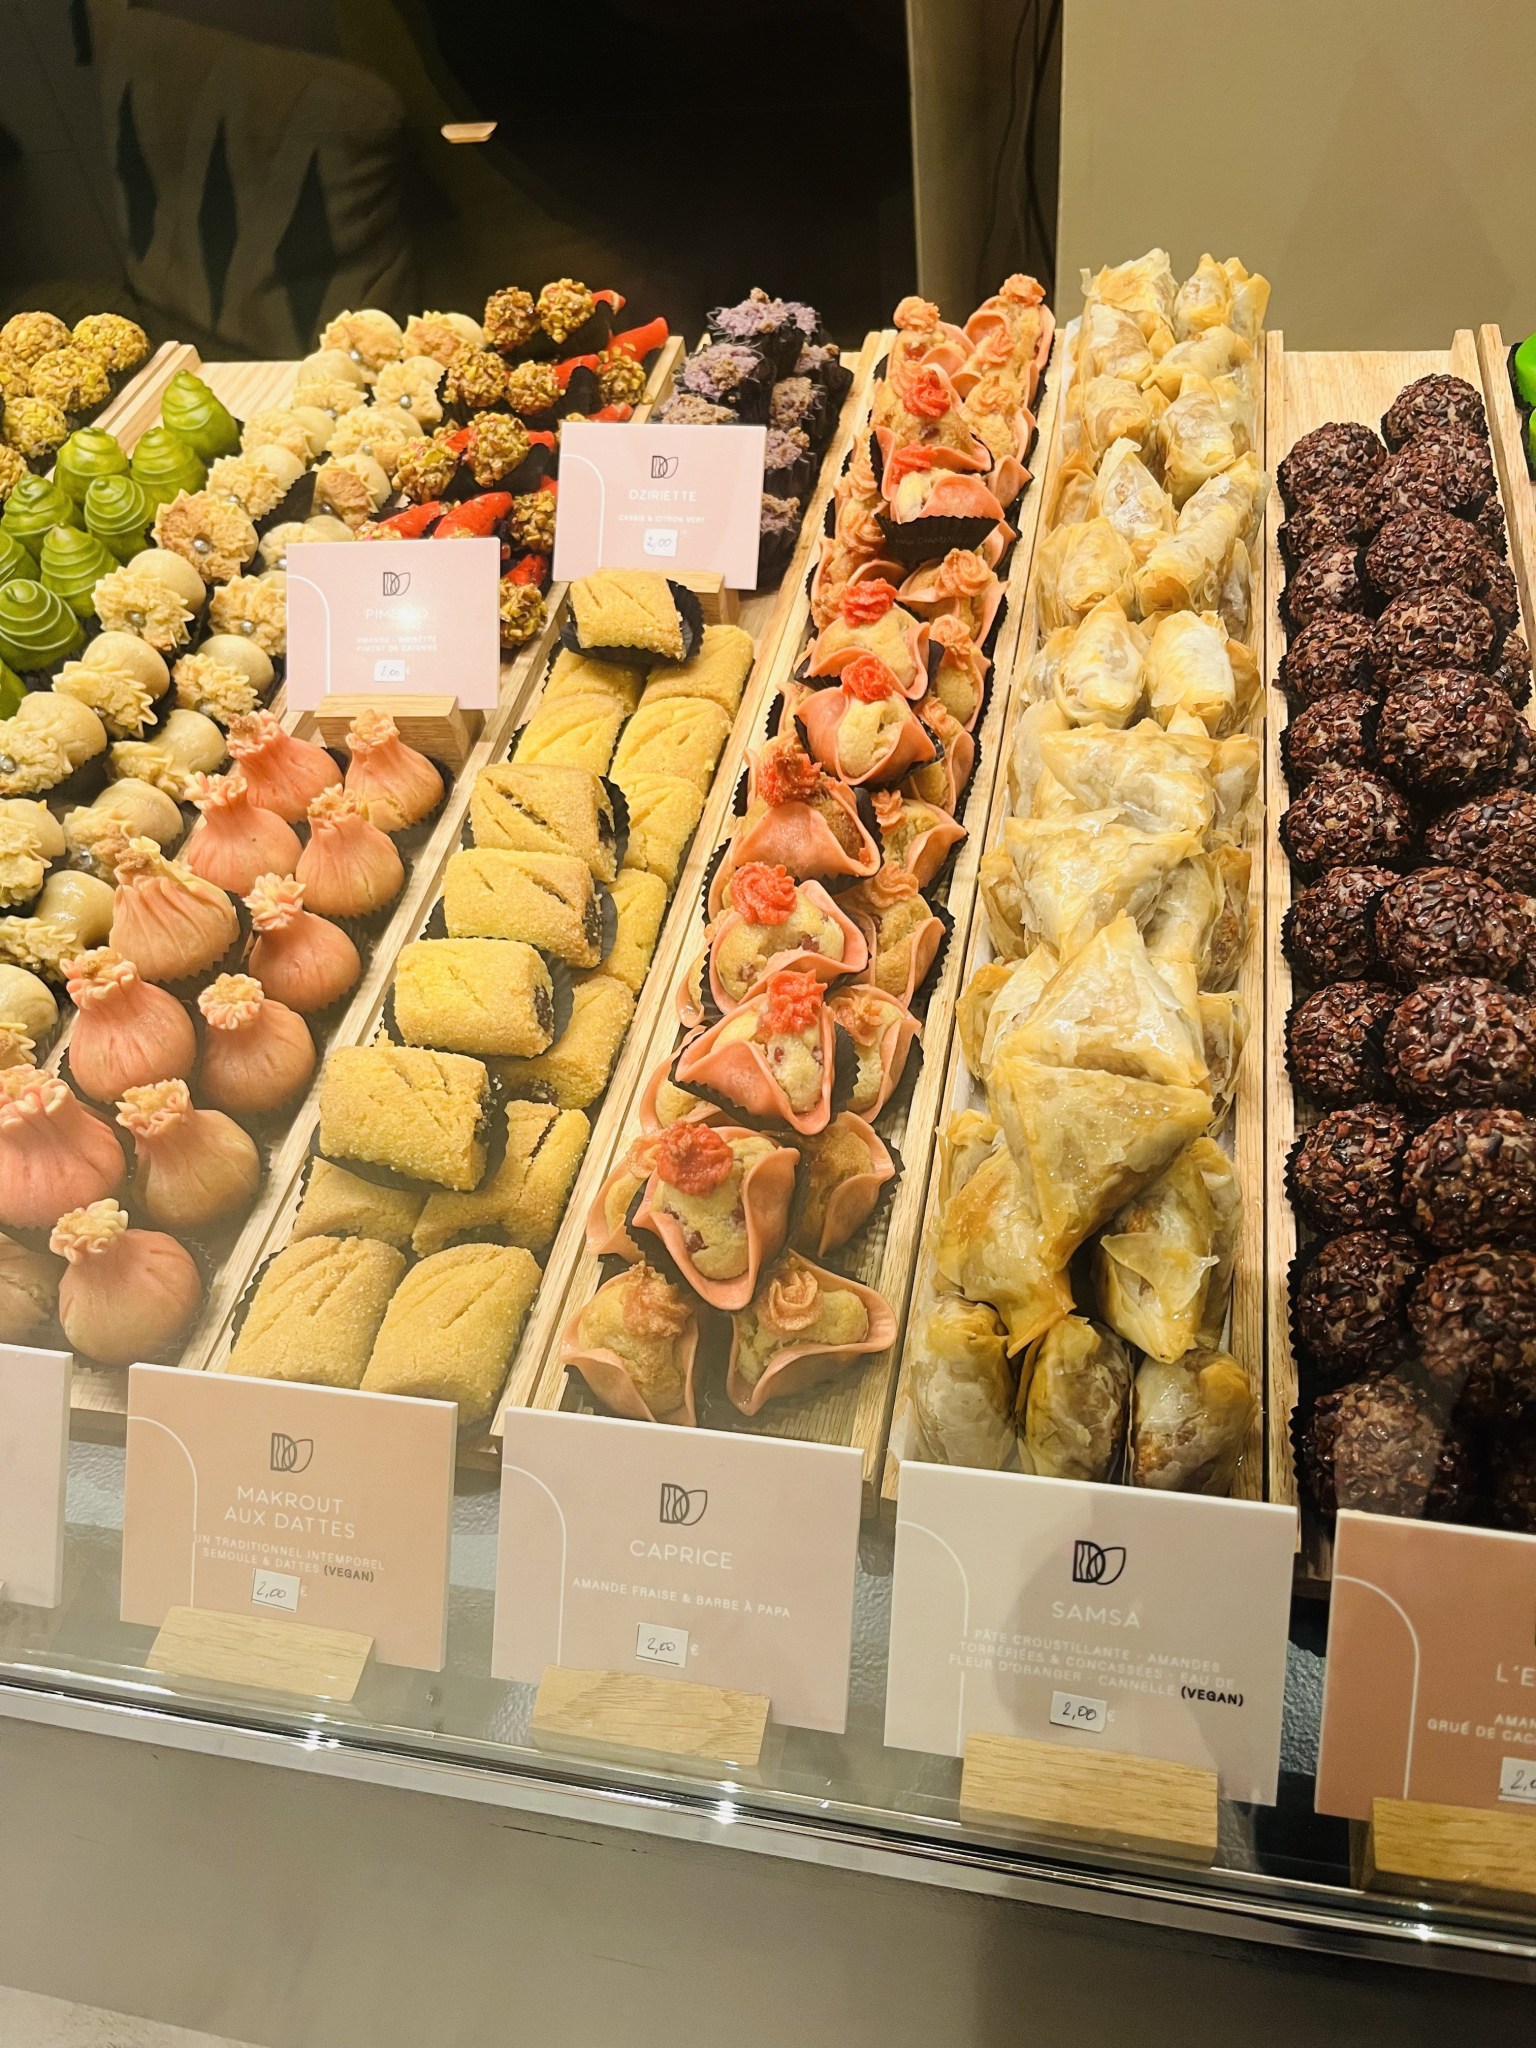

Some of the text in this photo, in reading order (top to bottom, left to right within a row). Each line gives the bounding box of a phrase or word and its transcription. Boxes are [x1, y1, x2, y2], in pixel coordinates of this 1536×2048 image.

[628, 488, 697, 502] DZIRIETTE
[655, 515, 684, 523] CITRON
[685, 516, 705, 524] VERT
[237, 1486, 343, 1515] MAKROUT
[224, 1506, 356, 1539] AUX DATTES
[194, 1533, 385, 1571] UN TRADITIONNEL INTEMPOREL
[202, 1547, 375, 1583] SEMOULE & DATTES (VEGAN)
[629, 1539, 733, 1570] CAPRICE
[256, 1581, 287, 1599] 2,00
[572, 1577, 791, 1618] AMANDE FRAISE & BARBE À PAPA
[1051, 1601, 1141, 1629] SAMSA
[647, 1637, 699, 1656] 2,00 €
[975, 1628, 1007, 1644] PÂTE
[1012, 1634, 1130, 1661] CROUSTILLANTE
[1147, 1653, 1220, 1673] AMANDES
[949, 1653, 992, 1669] FLEUR
[998, 1660, 1081, 1683] D'ORANGER
[1098, 1675, 1176, 1697] CANNELLE
[1180, 1686, 1244, 1707] (VEGAN)
[959, 1641, 1045, 1663] TORRÉFIÉES
[1050, 1654, 1060, 1666] &
[1065, 1656, 1162, 1679] CONCASSÉES
[1180, 1672, 1210, 1687] EAU
[1215, 1677, 1235, 1690] DE
[1062, 1701, 1097, 1721] 2,00
[1427, 1718, 1470, 1736] GRUÉ
[1476, 1725, 1496, 1740] DE
